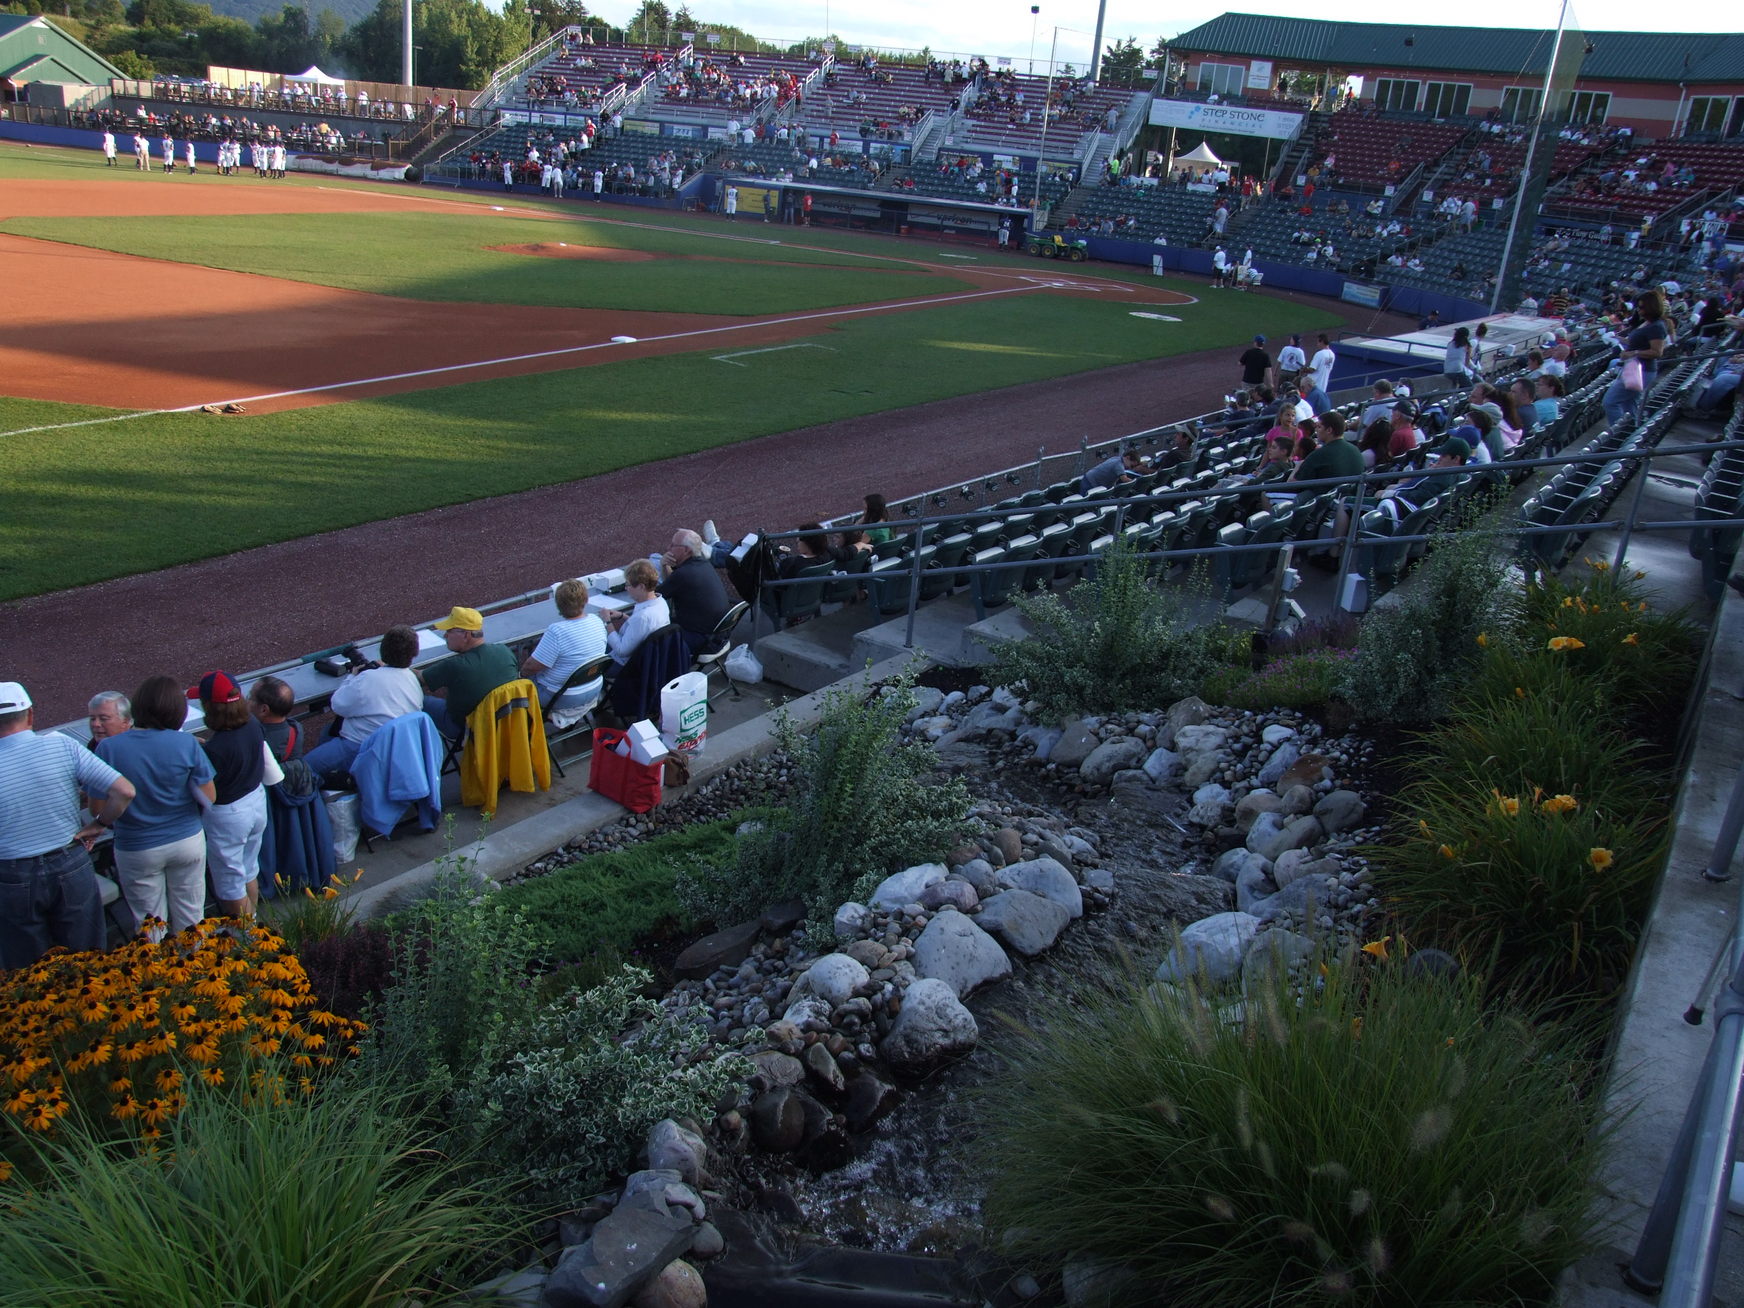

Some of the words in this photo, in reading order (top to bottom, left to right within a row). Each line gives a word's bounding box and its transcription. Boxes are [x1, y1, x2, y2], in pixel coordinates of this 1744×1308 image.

[1202, 108, 1228, 118] STEP
[1229, 111, 1265, 122] STONE
[1201, 118, 1263, 129] FINANCIAL
[683, 707, 705, 726] HESS
